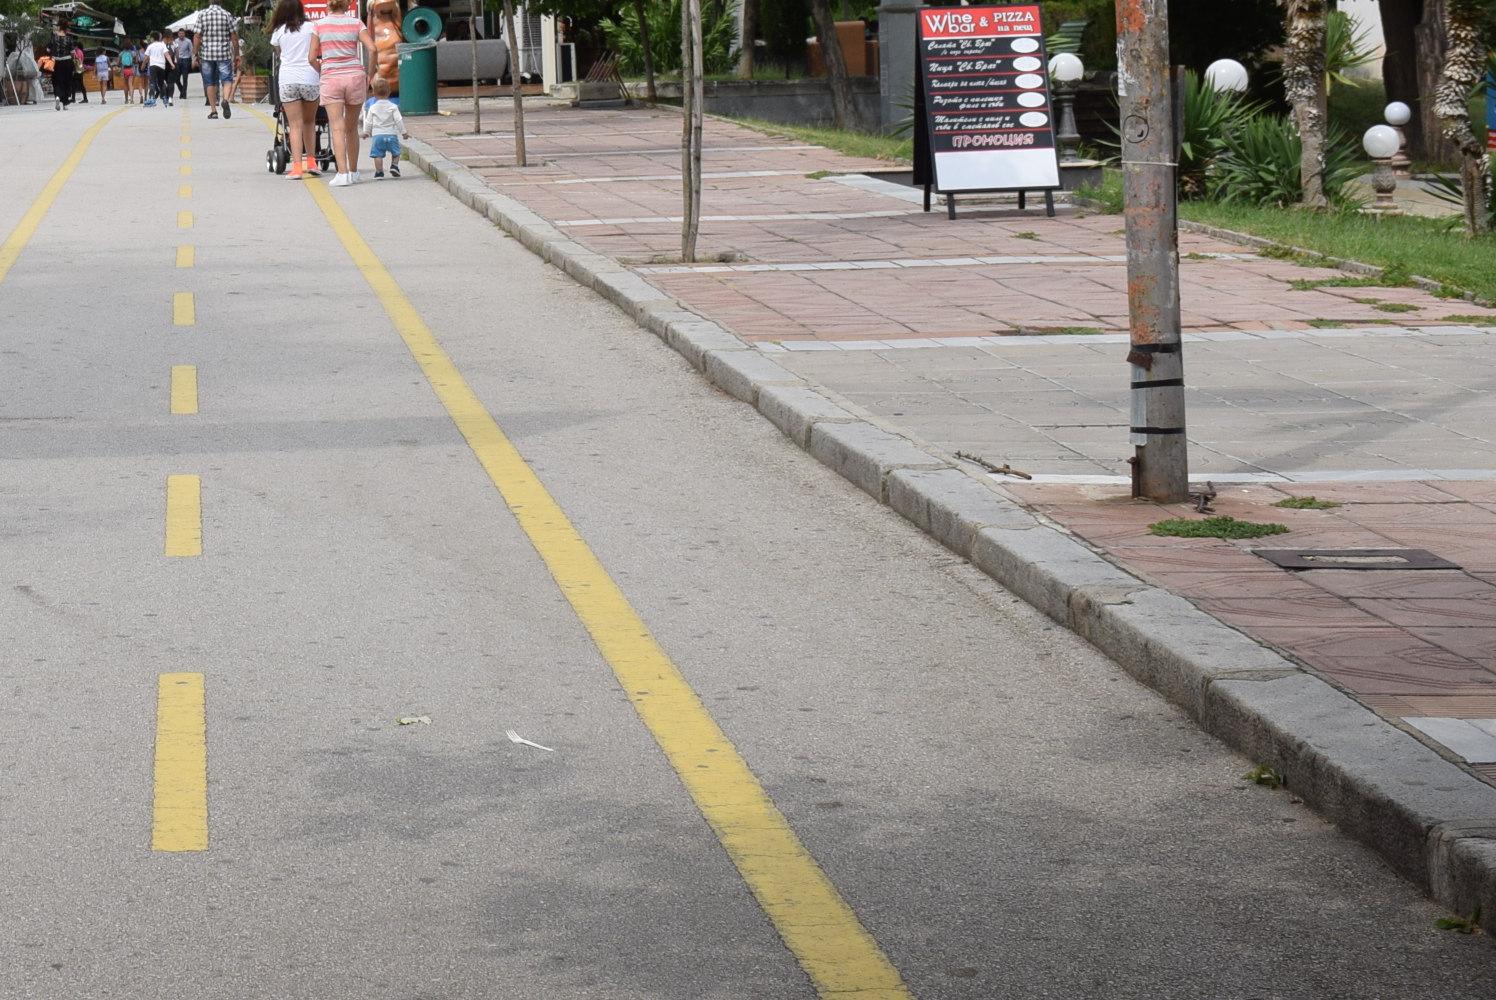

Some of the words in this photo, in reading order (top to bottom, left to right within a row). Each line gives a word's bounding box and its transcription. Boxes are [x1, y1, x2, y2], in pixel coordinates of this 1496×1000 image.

[925, 12, 973, 33] Wine
[979, 16, 989, 27] &
[993, 11, 1034, 22] PIZZA
[948, 21, 976, 33] bar
[1013, 24, 1033, 32] пещ
[929, 62, 953, 73] Пица
[952, 133, 1034, 148] ПРОМОЦИЯ
